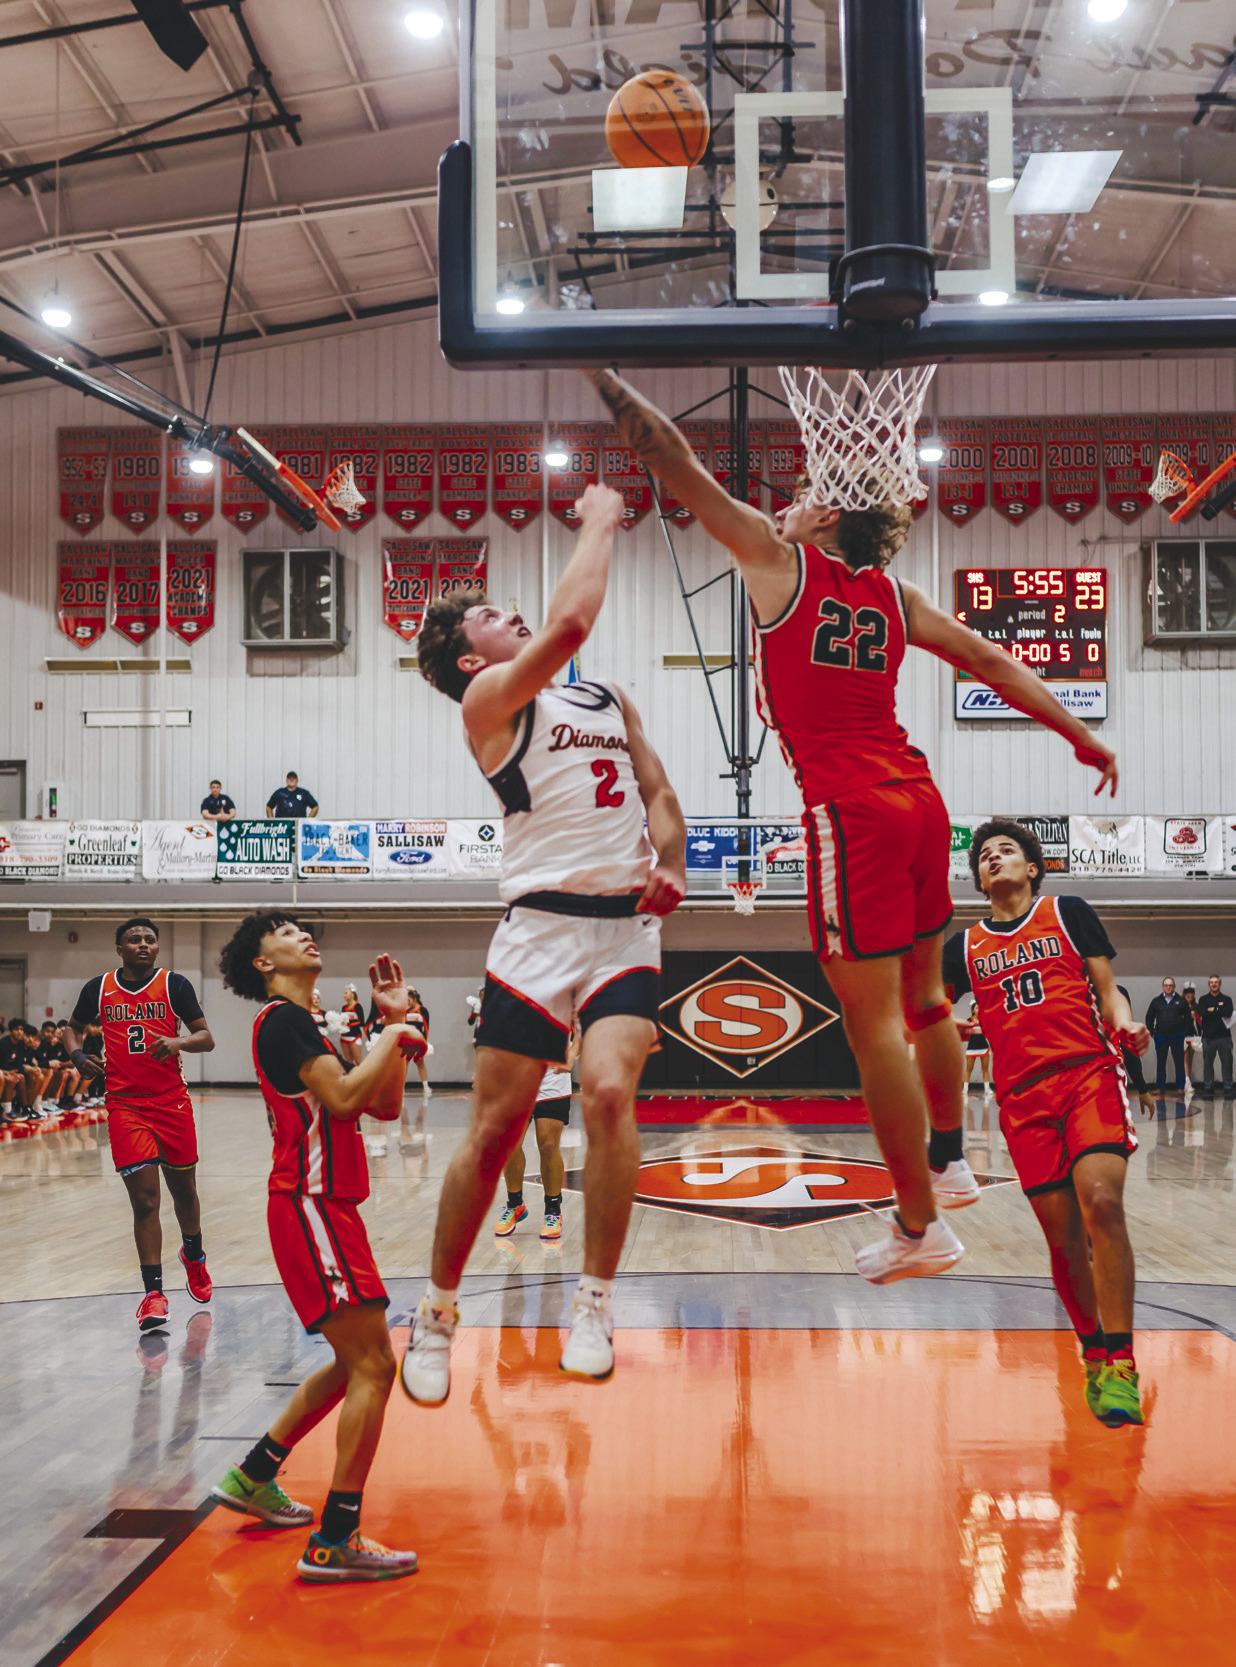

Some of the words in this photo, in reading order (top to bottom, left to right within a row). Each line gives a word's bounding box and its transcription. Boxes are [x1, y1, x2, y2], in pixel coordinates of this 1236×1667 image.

[992, 420, 1040, 430] SALLISAW
[1048, 418, 1096, 428] SALLISAW
[1103, 417, 1152, 427] SALLISAW
[1159, 416, 1208, 426] SALLISAW
[440, 426, 487, 436] SALLISAW
[495, 425, 542, 435] SALLISAW
[1104, 430, 1152, 439] WRESTLING
[1160, 429, 1182, 438] DUAL
[1185, 429, 1208, 438] TEAM
[584, 438, 597, 447] XC
[992, 432, 1040, 442] FOOTBALL
[441, 439, 470, 448] BOYS
[474, 439, 487, 448] XC
[495, 438, 524, 448] BOYS
[529, 438, 542, 448] XC
[995, 447, 1037, 468] 2001
[1048, 445, 1096, 467] 2008
[1104, 445, 1152, 465] 2009-10
[61, 456, 107, 477] 1952-53
[116, 457, 160, 477] 1980
[387, 454, 432, 475] 1982
[441, 453, 487, 474] 1982
[497, 453, 540, 474] 1983
[1050, 470, 1097, 480] ACADEMIC
[1116, 469, 1140, 479] STATE
[396, 479, 421, 488] STATE
[451, 477, 476, 488] STATE
[506, 477, 530, 487] STATE
[560, 477, 585, 487] STATE
[946, 485, 972, 498] 13-1
[1002, 484, 1028, 497] 13-1
[1054, 483, 1093, 493] CHAMPS
[70, 494, 97, 507] 24-4
[124, 493, 151, 507] 14-0
[952, 505, 967, 515] S
[1008, 503, 1024, 514] S
[1065, 502, 1080, 513] S
[1121, 501, 1136, 512] S
[75, 513, 91, 524] S
[129, 512, 145, 522] S
[183, 512, 201, 522] S
[236, 511, 253, 521] S
[401, 510, 416, 520] S
[456, 509, 471, 520] S
[510, 509, 526, 519] S
[386, 541, 431, 551] SALLISAW
[175, 556, 206, 565] CHEER
[126, 569, 150, 579] BAND
[397, 566, 421, 576] BAND
[450, 565, 475, 576] BAND
[170, 568, 210, 589] 2021
[967, 572, 984, 583] SHS
[1014, 571, 1063, 594] 5:55
[1076, 572, 1101, 583] GUEST
[63, 582, 106, 603] 2016
[117, 582, 159, 603] 2017
[389, 579, 428, 600] 2021
[167, 592, 213, 603] ACADEMIC
[973, 586, 992, 609] 13
[1075, 585, 1104, 609] 23
[171, 605, 209, 616] CHAMPS
[1018, 609, 1046, 621] period
[1054, 605, 1066, 622] 2
[130, 622, 146, 633] S
[182, 622, 199, 633] S
[399, 619, 417, 631] S
[75, 626, 92, 638] S
[811, 596, 889, 673] 22
[1017, 628, 1046, 640] player
[1059, 644, 1070, 661] 5
[1088, 643, 1099, 661] 0
[1080, 667, 1102, 677] match
[1073, 690, 1101, 698] Bank
[548, 724, 629, 752] Diamon
[591, 759, 625, 808] 2
[240, 823, 288, 838] Fullbright
[377, 823, 403, 833] HARRY
[405, 823, 446, 833] ROBINSON
[687, 827, 711, 837] BLUE
[1035, 821, 1067, 842] SULLIVAN
[78, 833, 128, 852] Greenleaf
[378, 836, 445, 847] SALLISAW
[235, 838, 260, 861] AUTO
[262, 838, 290, 861] WASH
[68, 854, 136, 865] PROPERTIES
[397, 849, 426, 864] Ford
[1071, 849, 1096, 864] SCA
[1099, 848, 1128, 866] Title,
[5, 867, 26, 875] BLACK
[219, 866, 228, 874] GO
[230, 866, 252, 874] BLACK
[774, 863, 797, 872] BLACK
[973, 936, 1062, 981] ROLAND
[999, 969, 1046, 1014] 10
[104, 1002, 166, 1022] ROLAND
[694, 982, 788, 1049] S
[127, 1025, 146, 1054] 2
